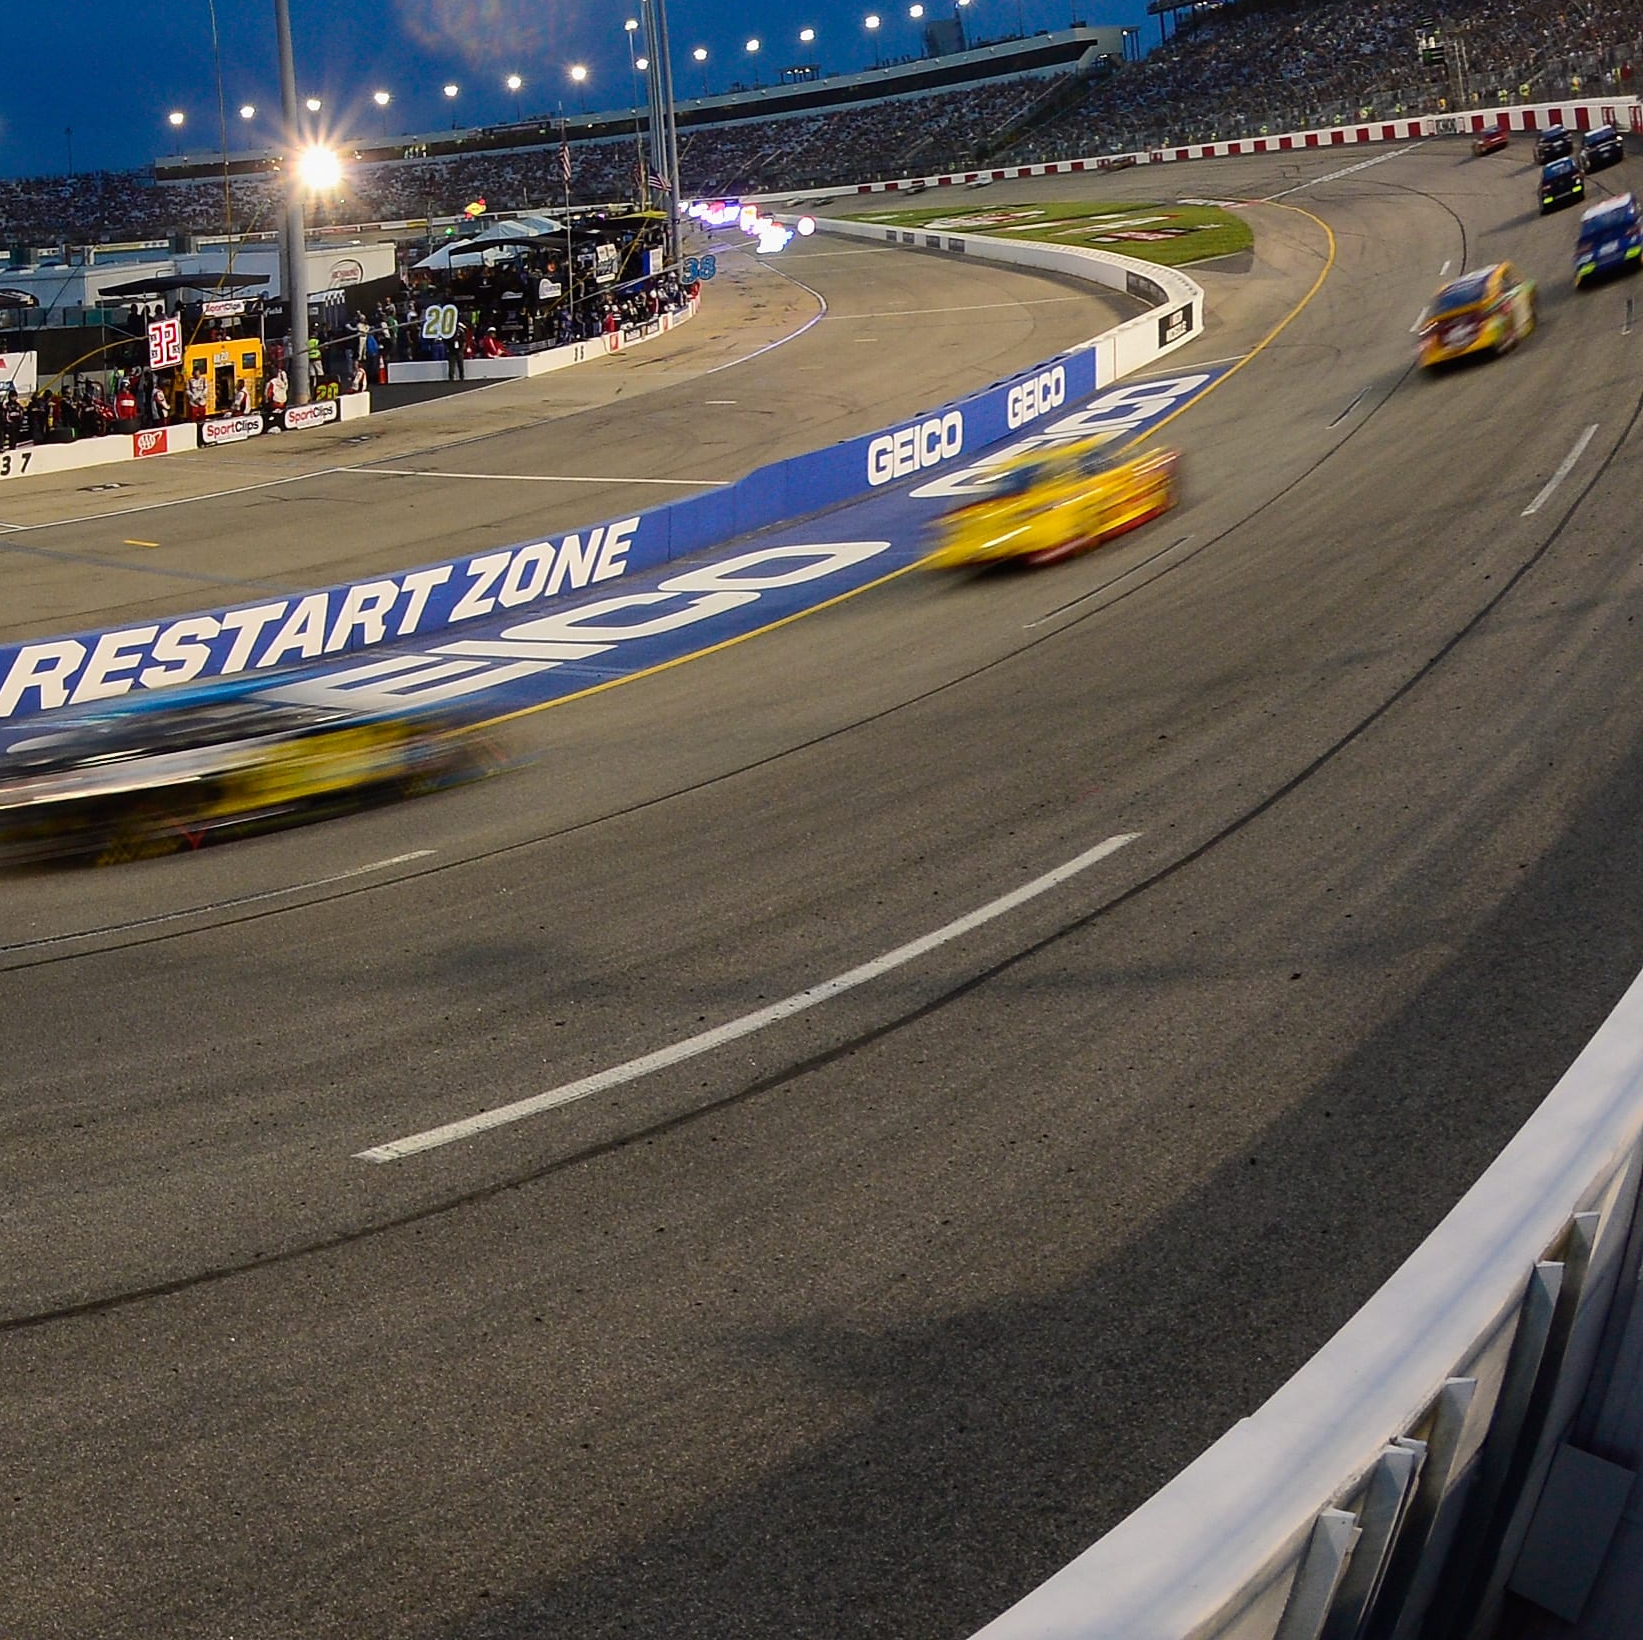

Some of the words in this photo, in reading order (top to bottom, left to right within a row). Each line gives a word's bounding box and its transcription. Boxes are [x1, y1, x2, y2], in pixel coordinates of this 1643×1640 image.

[681, 254, 716, 285] 38
[424, 306, 457, 338] 20
[1007, 365, 1065, 430] GEICO
[207, 418, 260, 438] SportClips
[287, 405, 333, 424] SportClips
[867, 410, 963, 487] GEICO
[447, 517, 642, 621] ZONE
